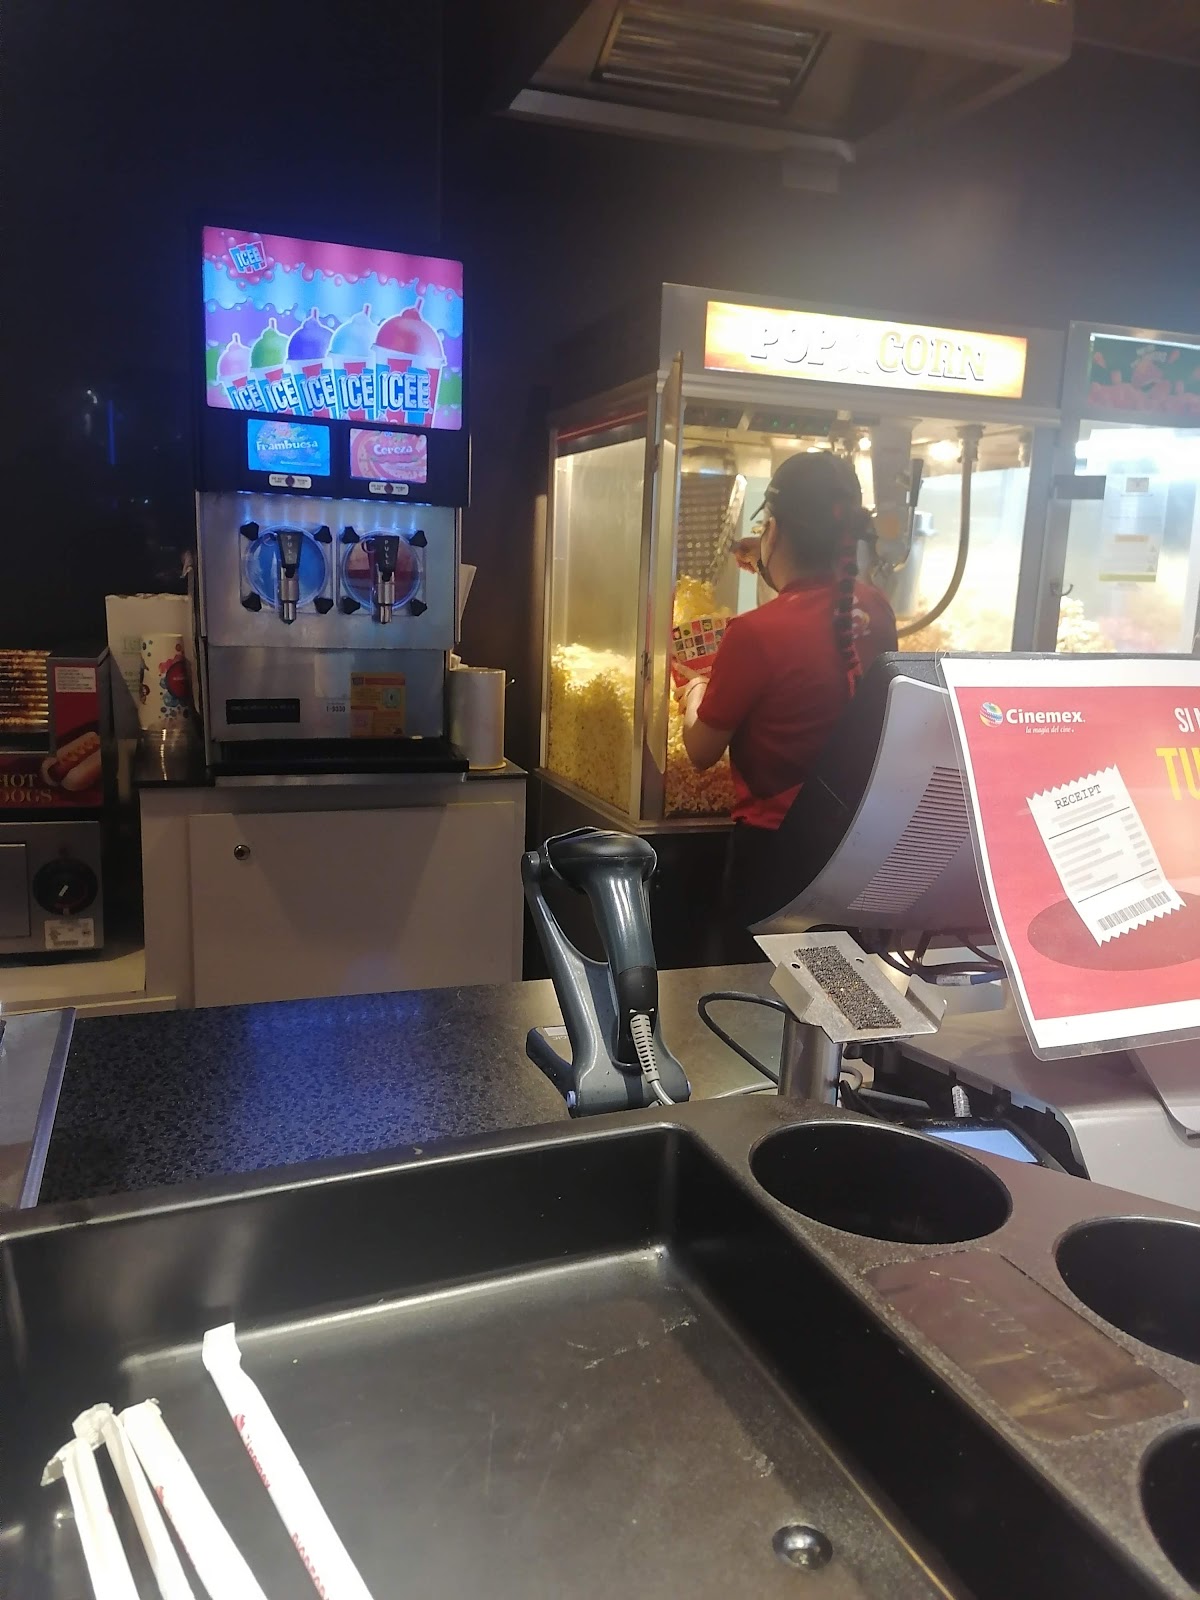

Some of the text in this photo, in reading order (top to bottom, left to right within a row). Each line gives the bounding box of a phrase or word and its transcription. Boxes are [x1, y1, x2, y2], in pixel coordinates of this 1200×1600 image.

[236, 246, 263, 268] ICEE
[875, 330, 986, 383] CORN
[379, 372, 429, 411] ICEE
[256, 439, 318, 451] Frambuesa
[373, 444, 413, 455] Cereza
[1006, 708, 1082, 724] Cinemex
[1174, 707, 1195, 733] SI
[1025, 726, 1031, 734] la
[1032, 727, 1050, 736] magia
[1051, 725, 1059, 733] del
[1054, 784, 1102, 810] RECEIPT
